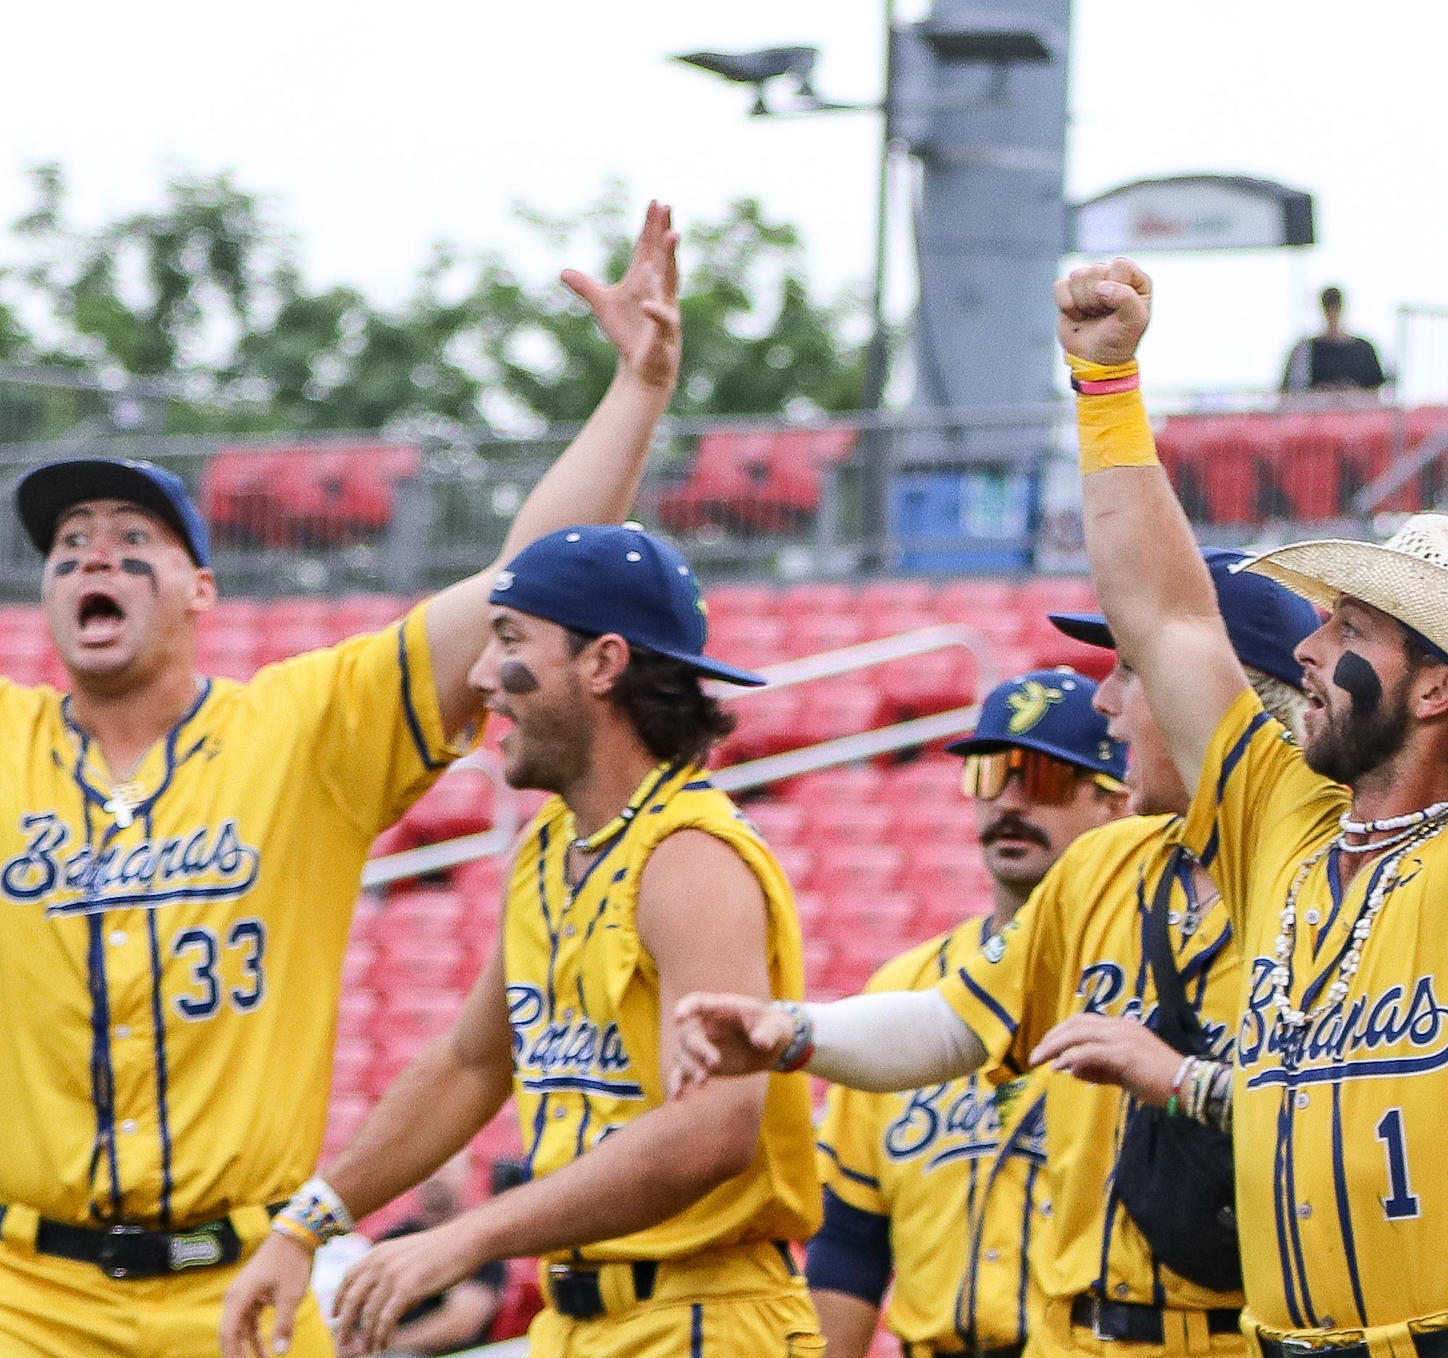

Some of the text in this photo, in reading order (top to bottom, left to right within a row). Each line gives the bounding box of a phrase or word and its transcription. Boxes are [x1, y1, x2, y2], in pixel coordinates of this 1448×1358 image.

[0, 811, 260, 918] Bananas
[174, 918, 268, 1022] 33
[1374, 1107, 1421, 1222] 1
